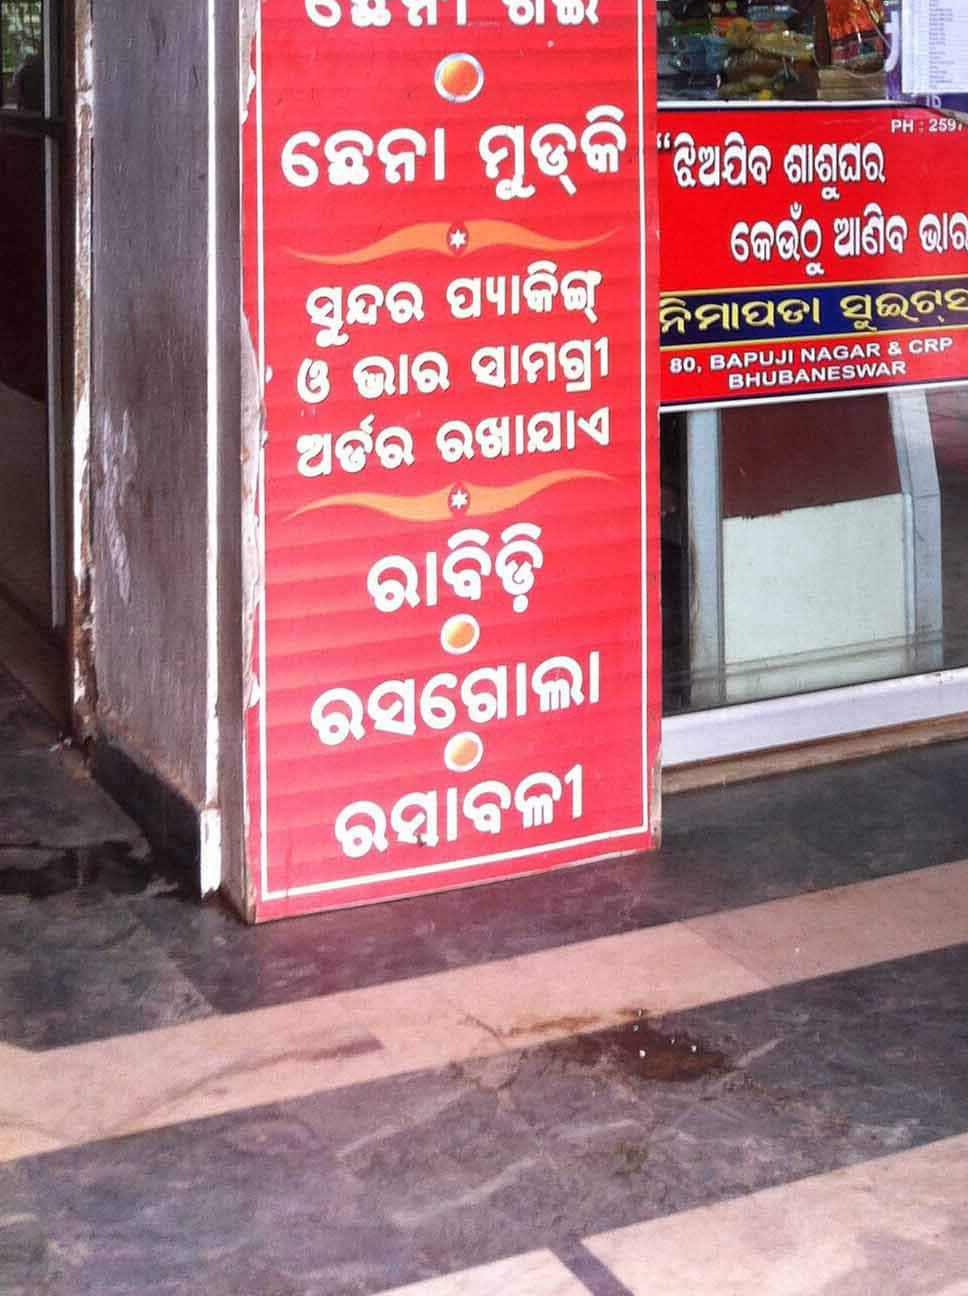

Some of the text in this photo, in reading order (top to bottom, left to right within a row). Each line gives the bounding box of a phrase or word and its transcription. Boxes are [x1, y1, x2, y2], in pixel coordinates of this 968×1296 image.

[890, 118, 914, 134] PH
[280, 126, 447, 188] ଛେନା
[710, 348, 794, 371] BAPUJI
[801, 342, 881, 364] NAGAR
[887, 340, 902, 356] &
[908, 336, 954, 355] CRP
[728, 360, 907, 391] BHUBANESWAR
[297, 356, 331, 405] ଓ
[352, 350, 450, 401] ଭାର
[310, 649, 601, 747] ରସଗୋଲା
